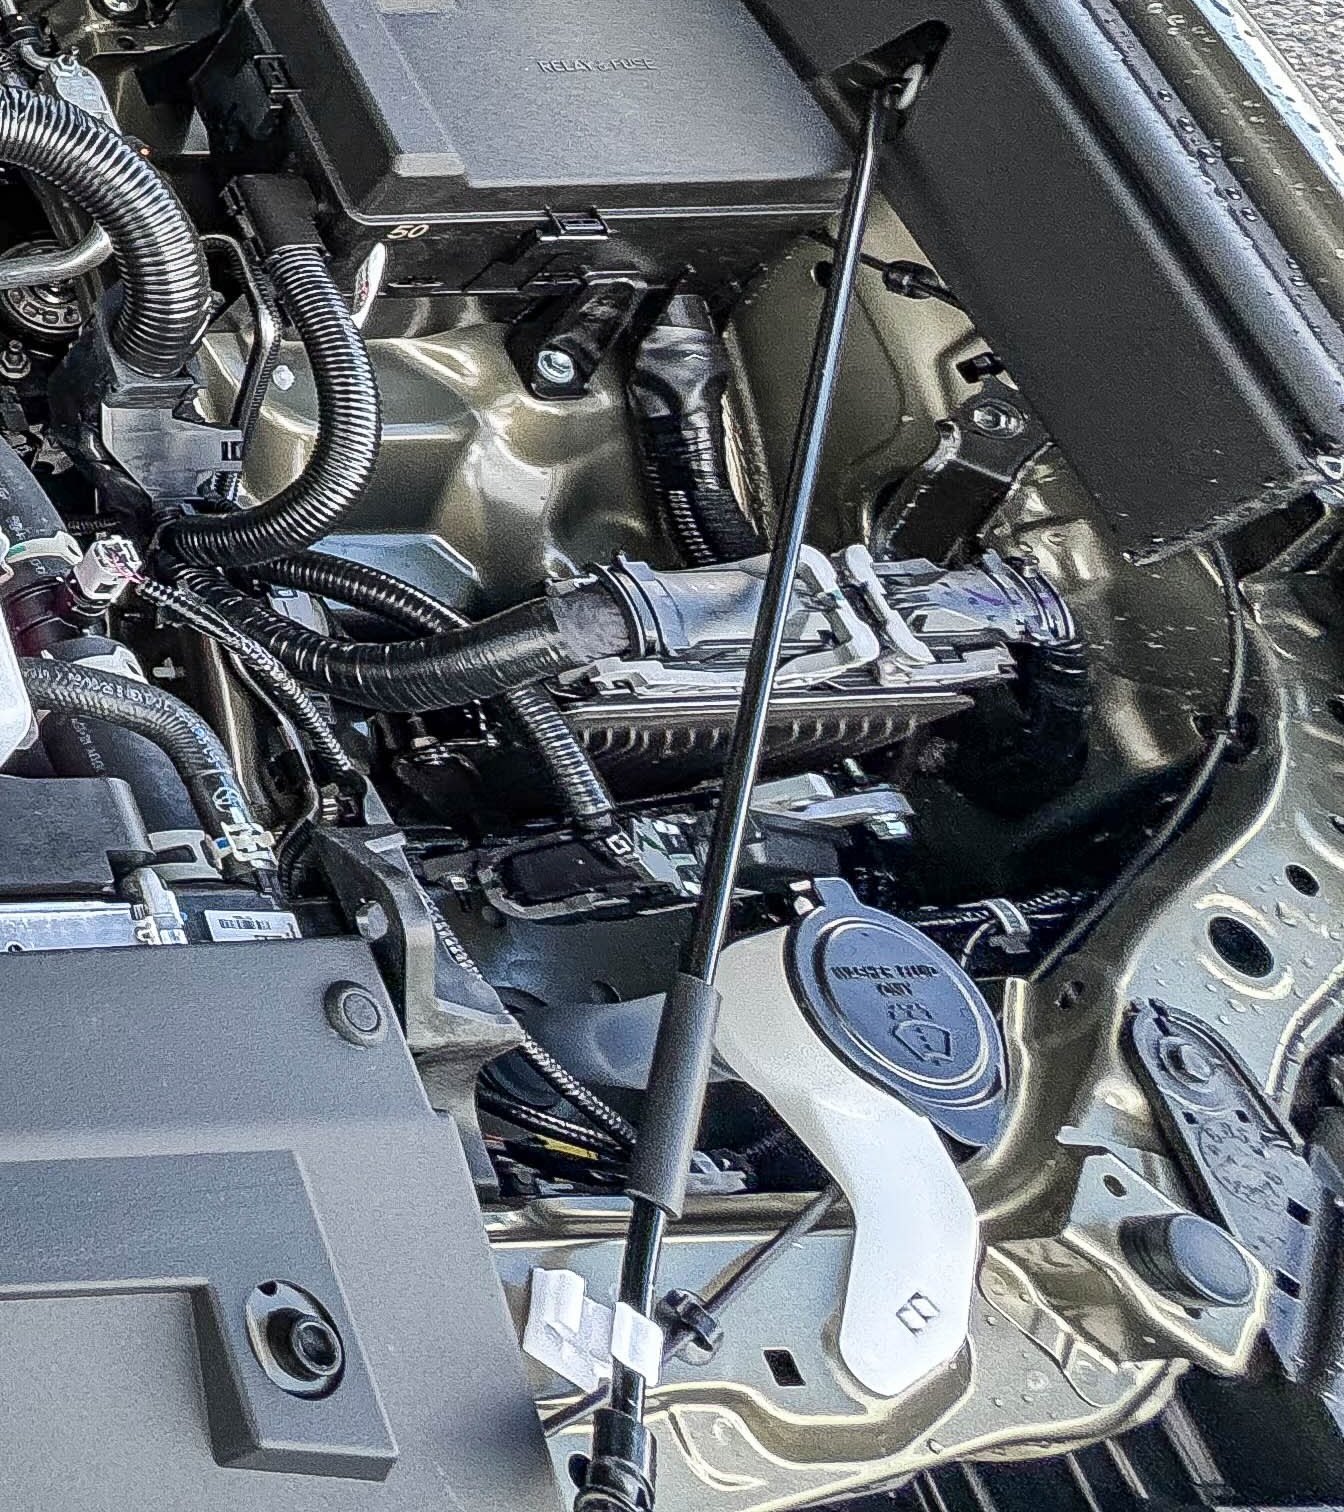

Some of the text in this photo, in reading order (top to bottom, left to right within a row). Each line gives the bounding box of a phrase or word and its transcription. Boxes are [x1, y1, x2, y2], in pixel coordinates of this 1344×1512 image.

[537, 59, 593, 73] RELAY
[610, 57, 658, 71] FUSE
[386, 224, 430, 239] 50
